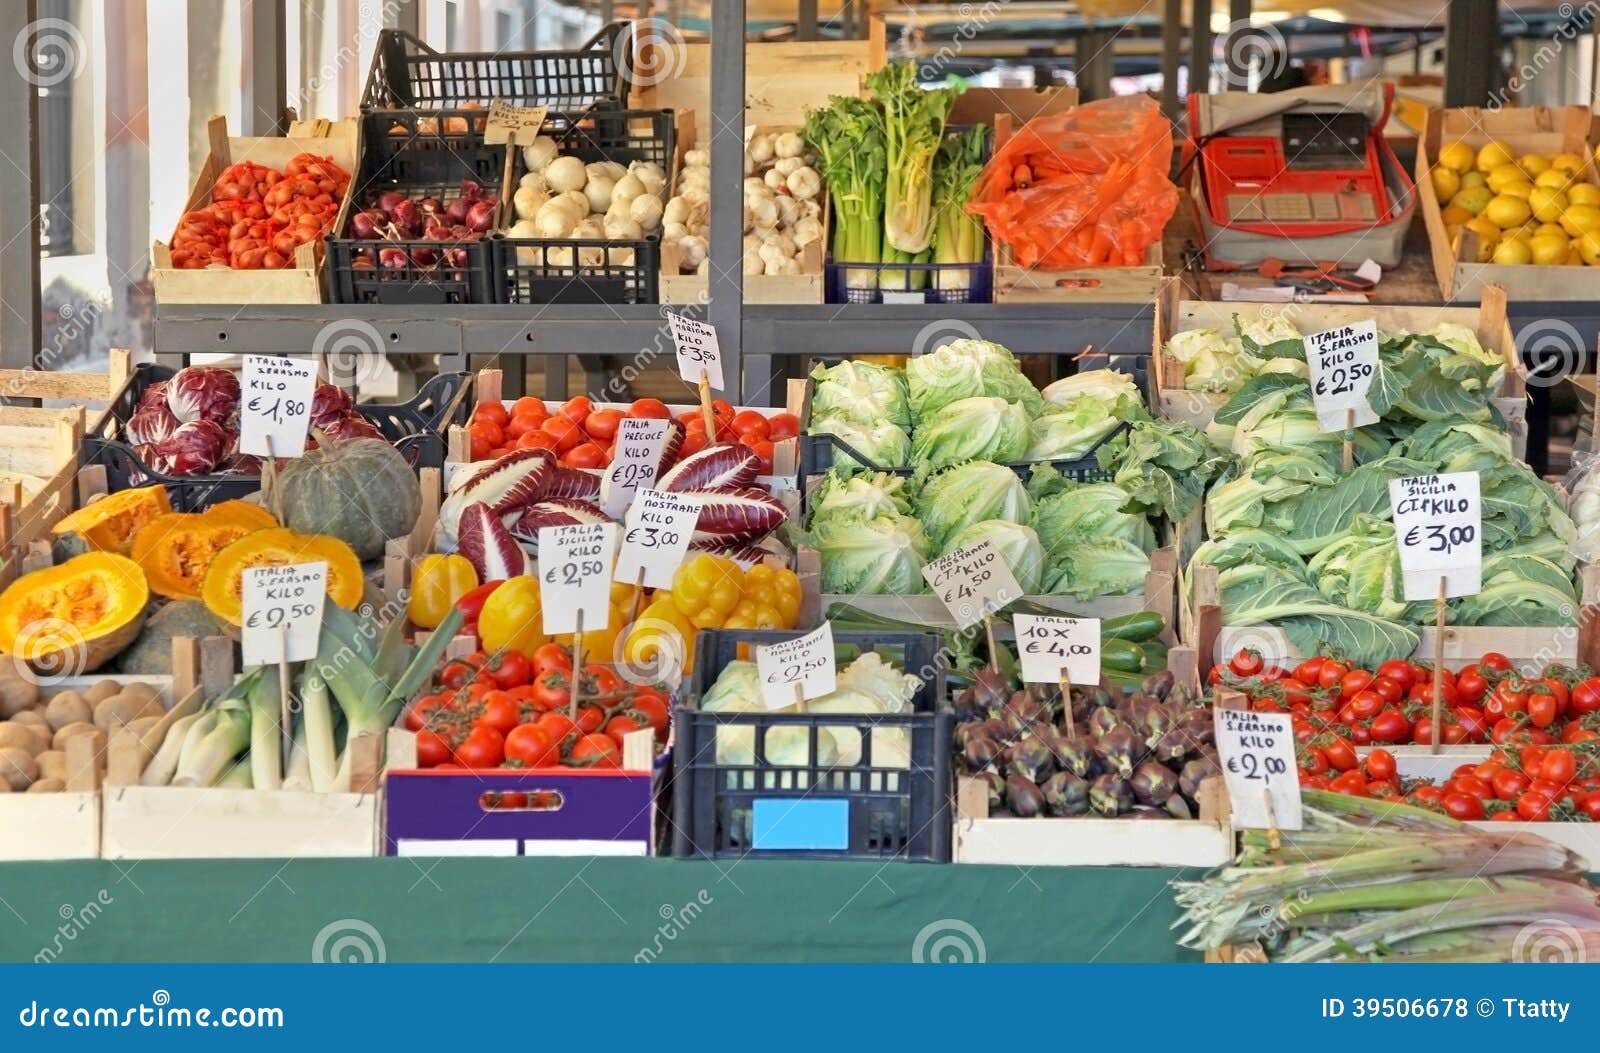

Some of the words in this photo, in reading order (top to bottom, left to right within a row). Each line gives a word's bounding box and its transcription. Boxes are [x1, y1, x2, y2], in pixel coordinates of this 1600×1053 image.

[677, 332, 703, 345] KILO
[1311, 327, 1354, 345] ITALIA
[249, 357, 294, 367] ITALIA
[1322, 351, 1354, 370] KILO
[250, 380, 286, 391] KILO
[623, 420, 650, 429] ITALIA
[624, 431, 664, 441] PRECOCE
[624, 447, 650, 458] KILO
[1401, 475, 1440, 487] ITALIA
[642, 489, 678, 501] ITALIA
[1408, 483, 1457, 496] SICILIA
[640, 511, 674, 525] KILO
[553, 524, 603, 537] ITALIA
[556, 535, 605, 546] SICILIA
[568, 545, 602, 558] KILO
[929, 547, 965, 571] ITALIA
[254, 567, 297, 578] ITALIA
[266, 587, 305, 600] KILO
[1035, 617, 1079, 625] ITALIA
[1021, 625, 1049, 638] 10
[764, 640, 803, 652] ITALIA
[780, 650, 810, 664] KILO
[1221, 710, 1259, 722] ITALIA
[1240, 736, 1275, 748] KILO
